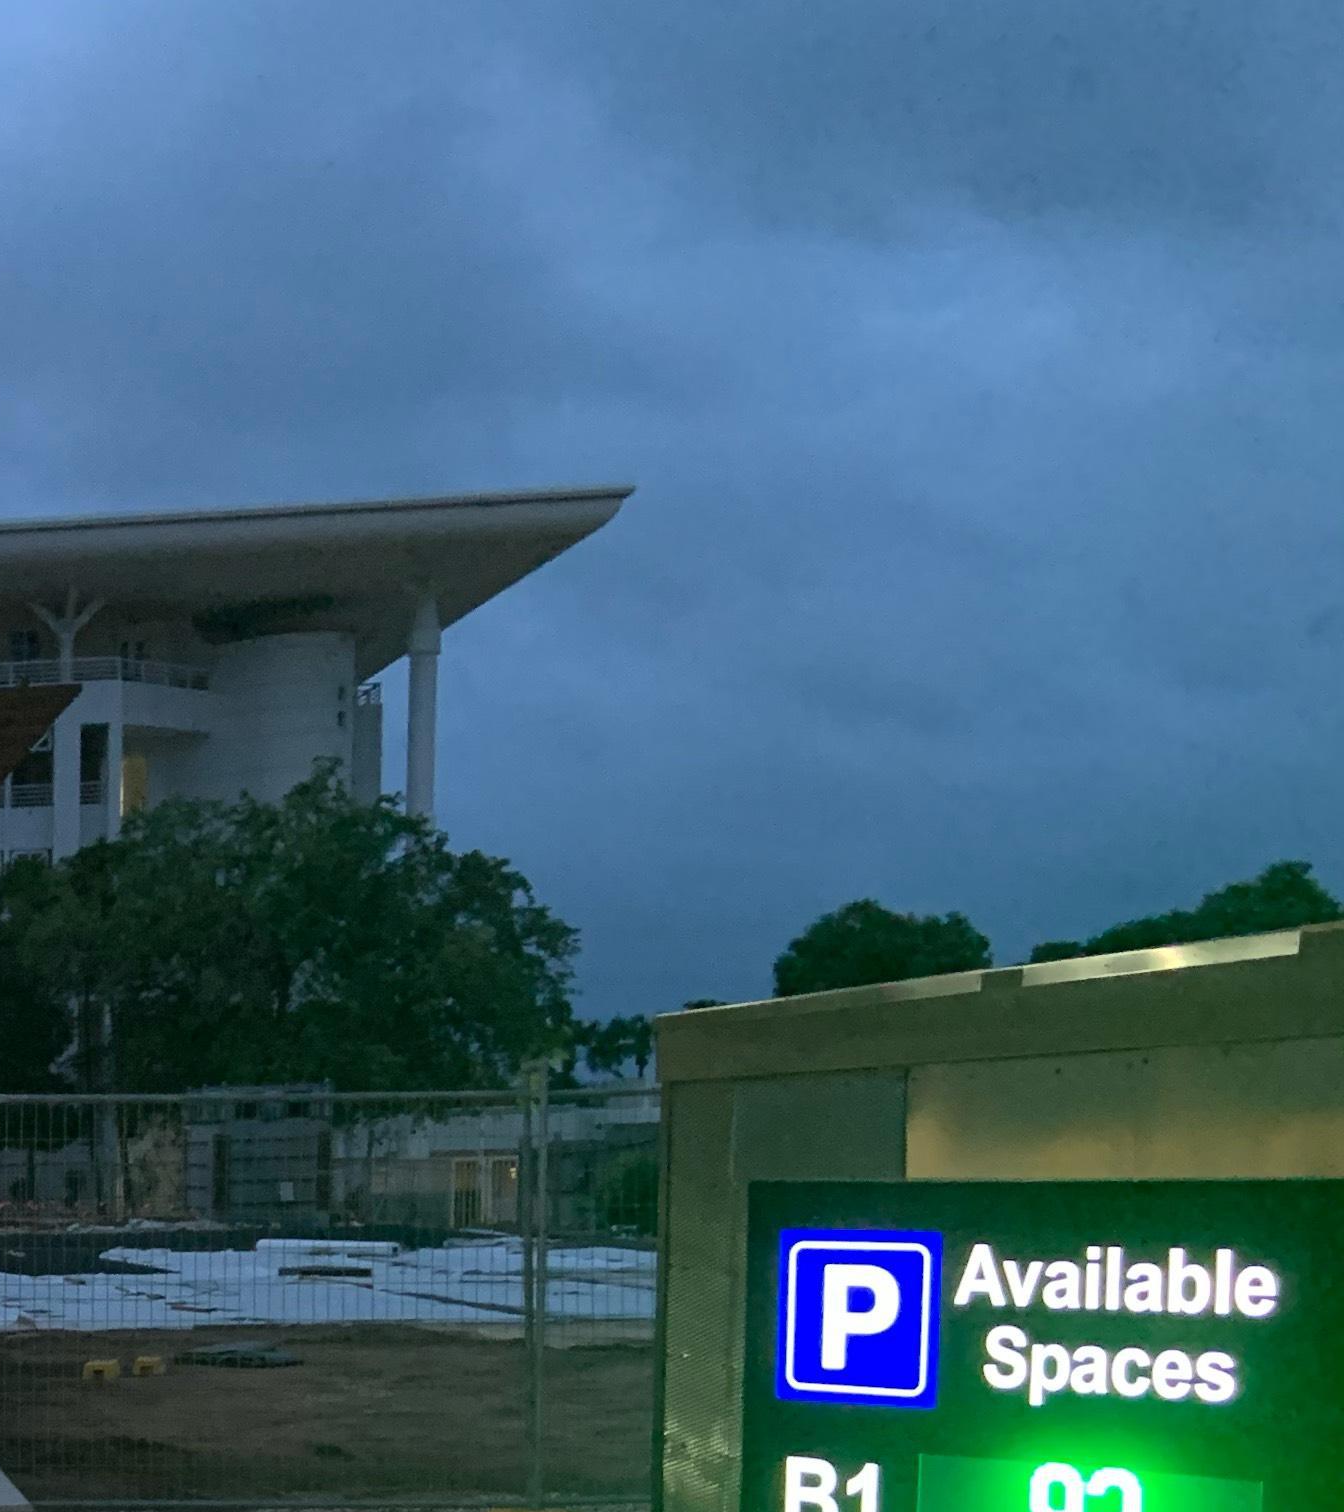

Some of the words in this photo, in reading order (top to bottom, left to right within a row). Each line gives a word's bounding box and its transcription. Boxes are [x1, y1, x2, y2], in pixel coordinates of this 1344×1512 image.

[820, 1262, 902, 1371] P
[954, 1243, 1279, 1318] Available
[983, 1325, 1238, 1406] Spaces
